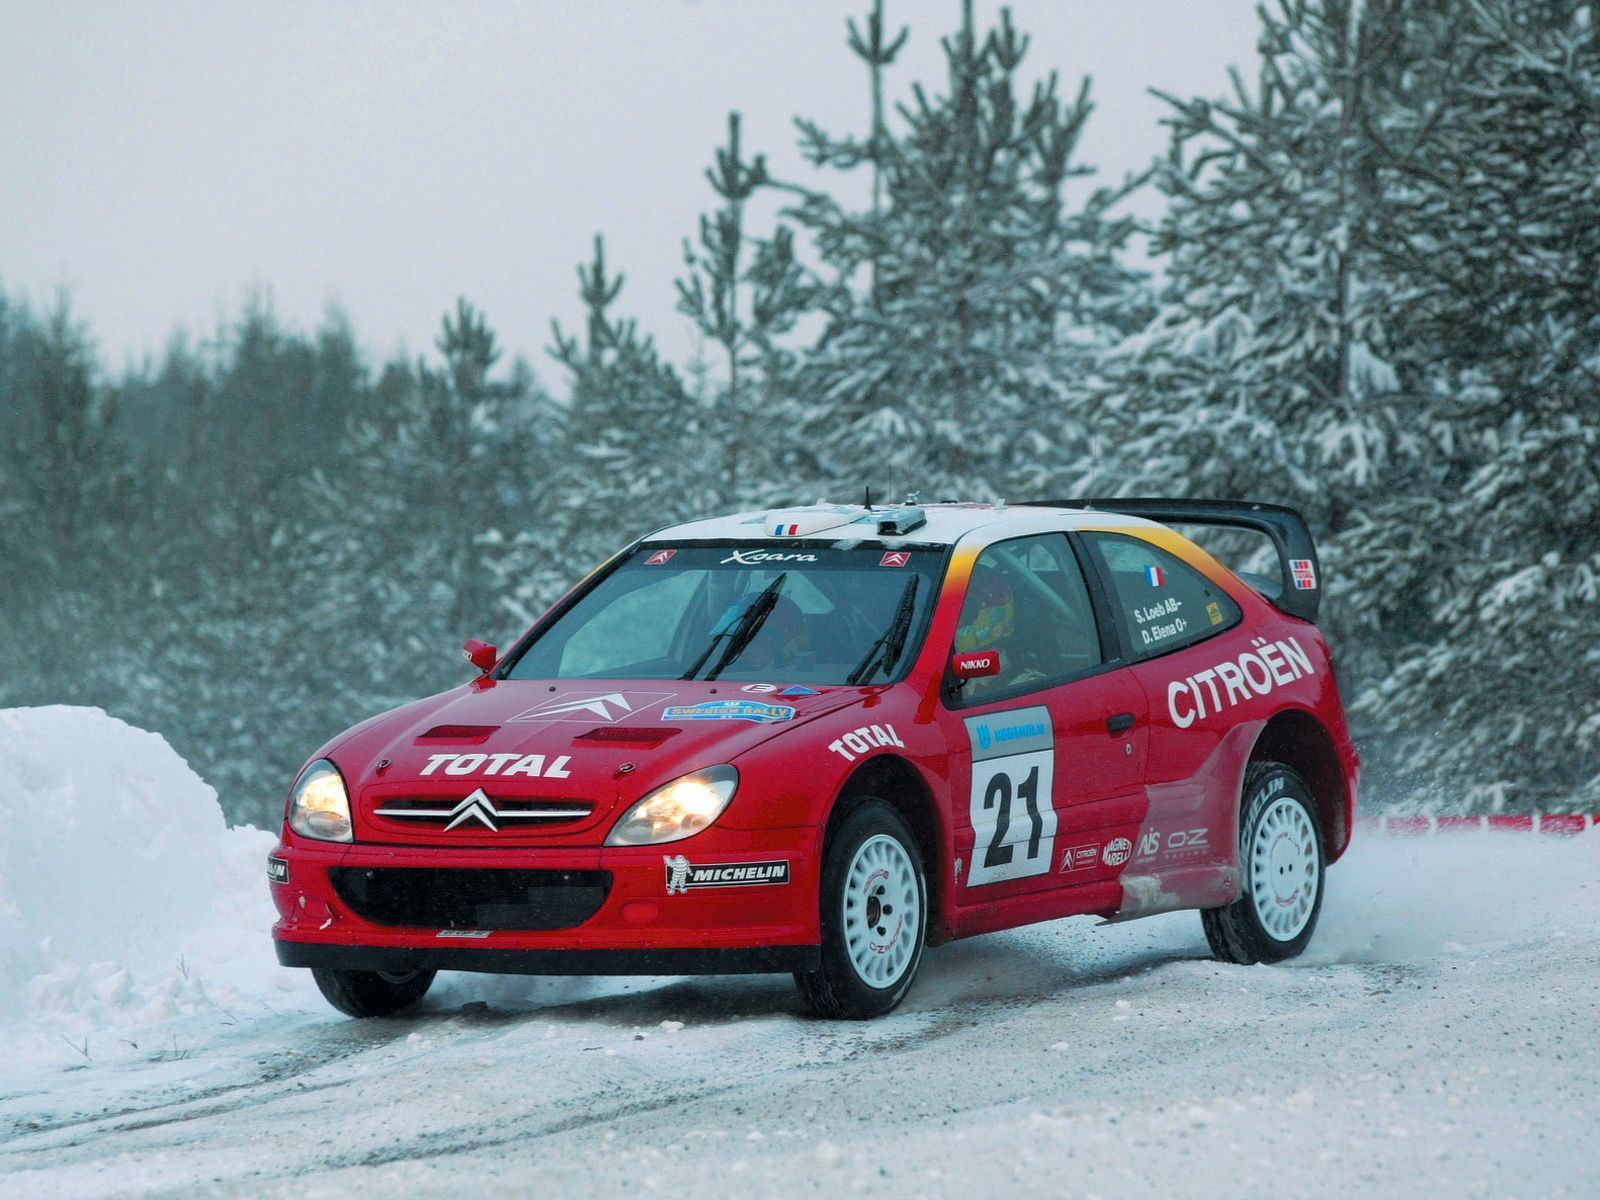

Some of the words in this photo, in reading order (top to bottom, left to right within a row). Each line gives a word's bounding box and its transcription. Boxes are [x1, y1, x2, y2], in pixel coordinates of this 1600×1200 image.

[720, 549, 819, 565] Xsara
[1134, 609, 1146, 624] S.
[1143, 602, 1166, 621] Loeb
[1141, 629, 1154, 644] D.
[1151, 623, 1177, 641] Elena
[960, 658, 990, 670] NIKKO
[1168, 637, 1315, 729] CITROËN
[828, 723, 905, 761] TOTAL
[419, 753, 572, 779] TOTAL
[983, 766, 1042, 868] 21
[693, 864, 786, 882] MICHELIN
